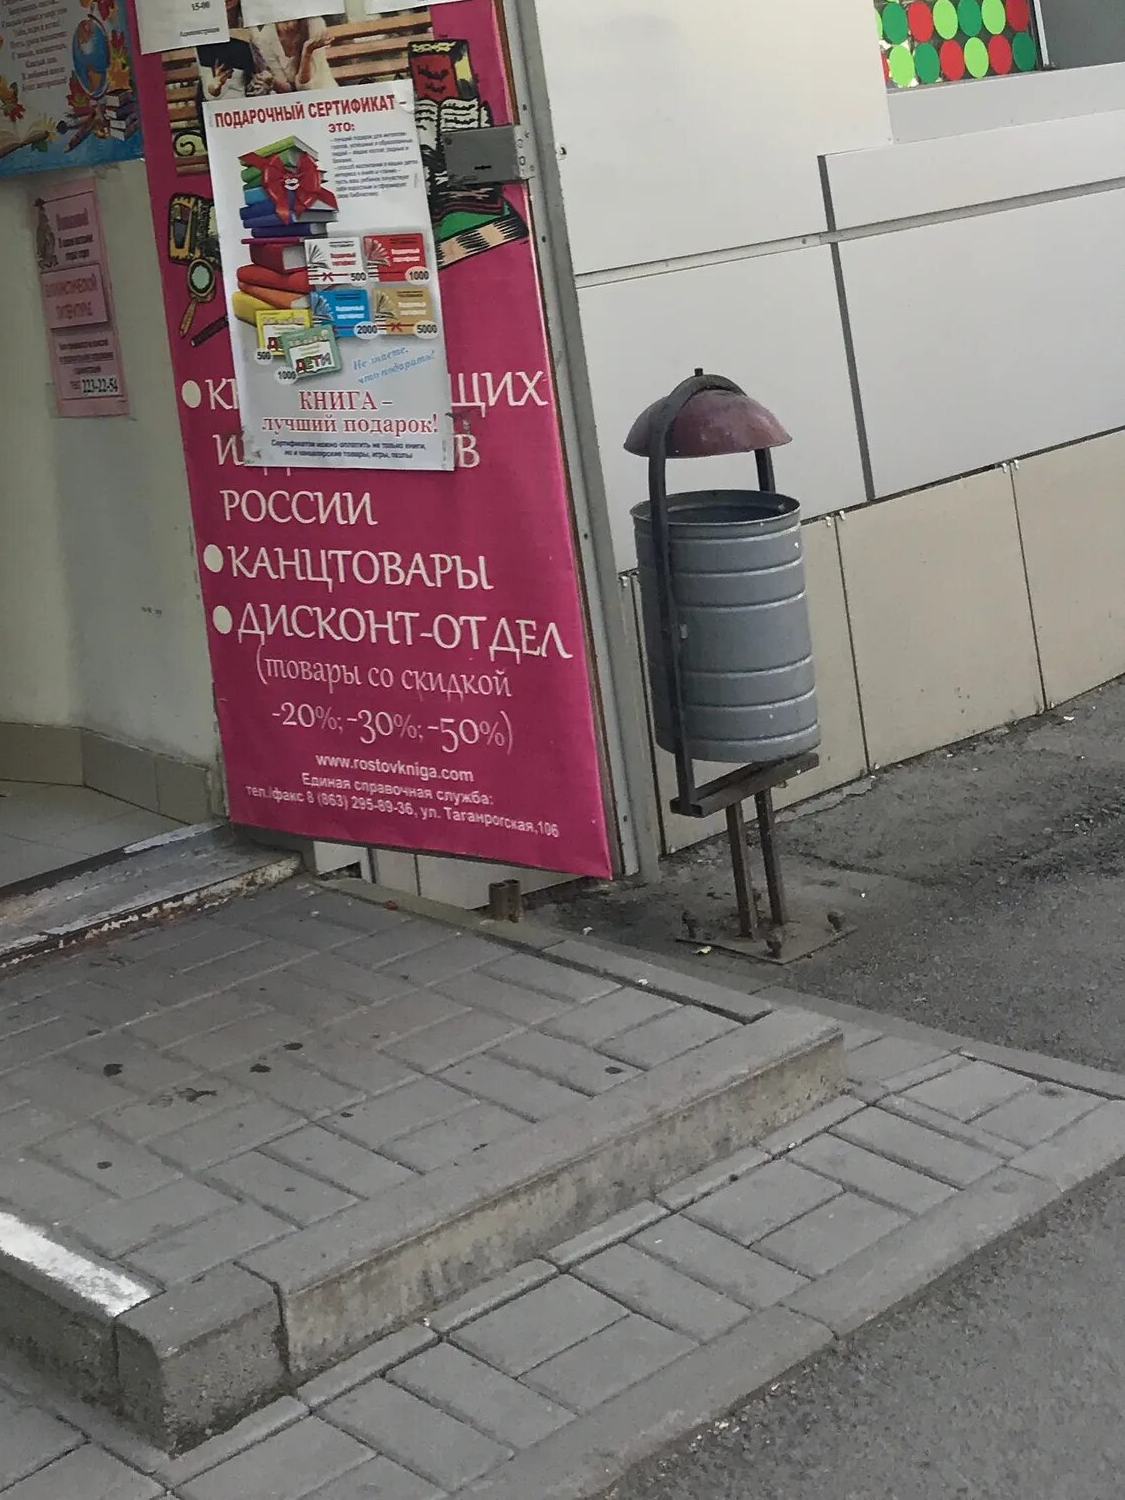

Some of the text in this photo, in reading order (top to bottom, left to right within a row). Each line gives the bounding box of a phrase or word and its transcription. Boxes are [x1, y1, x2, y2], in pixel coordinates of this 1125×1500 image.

[214, 101, 305, 130] ПОДАРОЧНЫЙ
[308, 93, 396, 118] СЕРТИФИКАТ
[327, 121, 356, 134] ЭТО:
[350, 270, 430, 282] 500 1000
[356, 323, 438, 335] 2000 5000
[256, 351, 272, 361] 500
[295, 352, 332, 374] ДЕТИ
[277, 370, 297, 381] 1000
[299, 390, 378, 411] КНИГА
[262, 413, 439, 438] лучший подарок!
[220, 490, 378, 526] РОССИИ
[227, 545, 494, 593] КАНЦТОВАРЫ
[237, 602, 573, 664] ДИСКОНТ-ОТДЕЛ
[256, 644, 513, 702] (товары со скидкой
[315, 753, 474, 783] www.rostovkniga.com
[301, 772, 495, 807] Единая справочная служба:
[306, 790, 315, 805] 8
[316, 792, 349, 811] (863)
[420, 804, 442, 820] ул.
